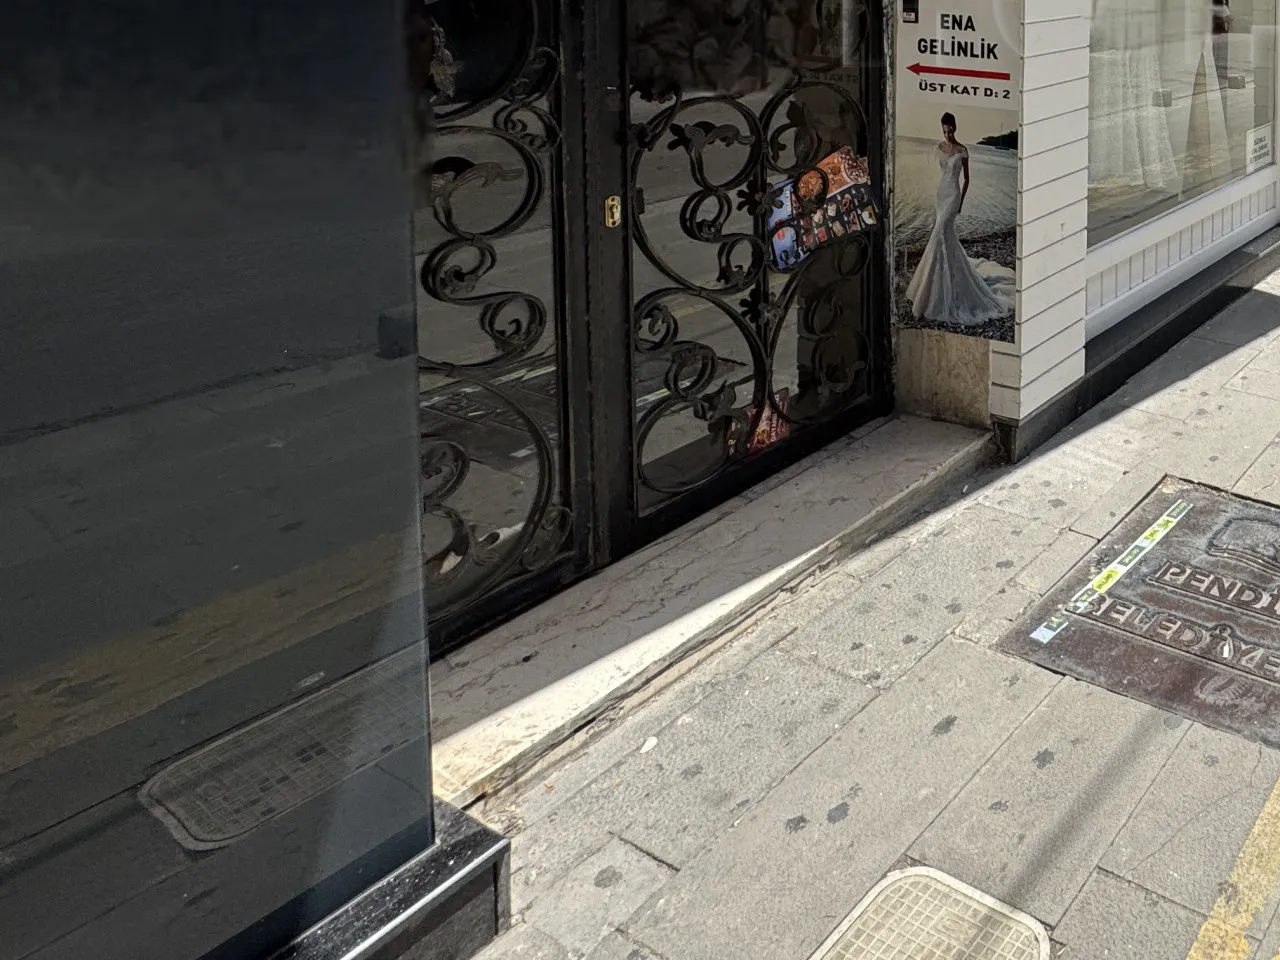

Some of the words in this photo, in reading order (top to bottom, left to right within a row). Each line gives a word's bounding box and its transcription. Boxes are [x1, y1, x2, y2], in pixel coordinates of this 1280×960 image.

[940, 13, 976, 32] ENA
[917, 35, 999, 60] GELİNLİK
[918, 78, 946, 93] ÜST
[950, 84, 980, 97] KAT
[983, 87, 999, 98] D:
[1002, 90, 1011, 99] 2
